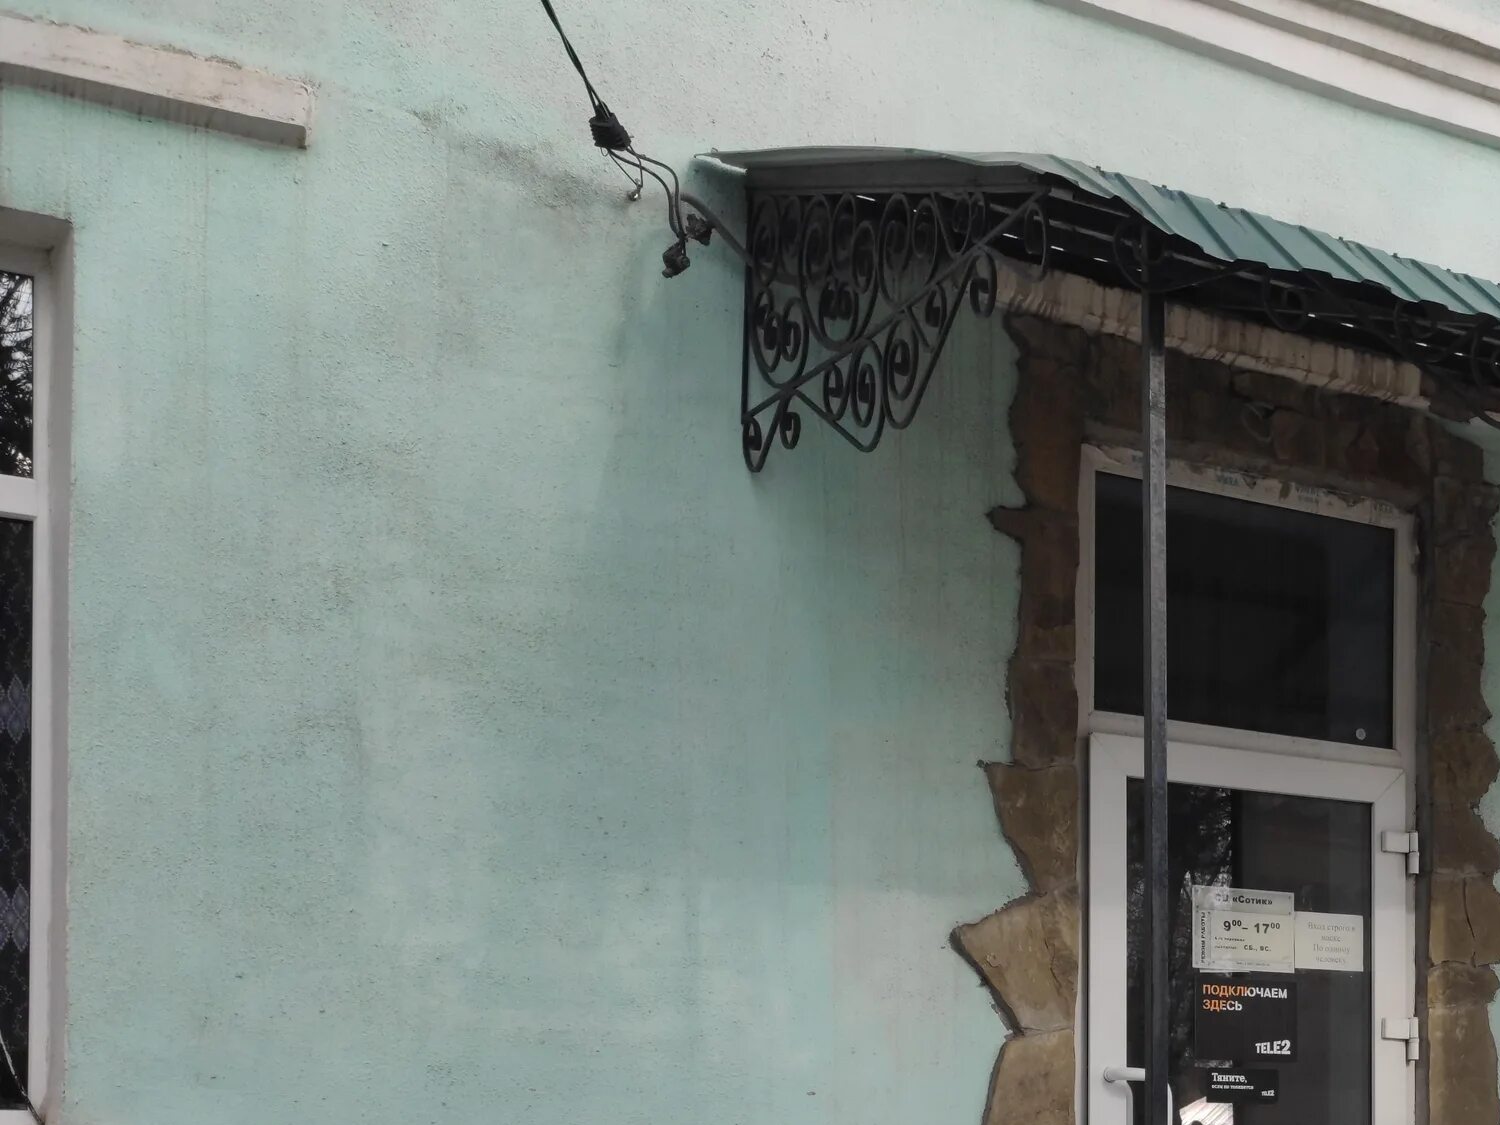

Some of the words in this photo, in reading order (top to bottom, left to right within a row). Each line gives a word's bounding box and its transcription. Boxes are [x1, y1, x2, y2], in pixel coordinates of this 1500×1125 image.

[1202, 984, 1288, 999] ПОДКЛЮЧАЕМ
[1202, 999, 1243, 1012] ЗДЕСЬ
[1255, 1040, 1291, 1055] TELE2
[1211, 1072, 1248, 1083] Тяните,
